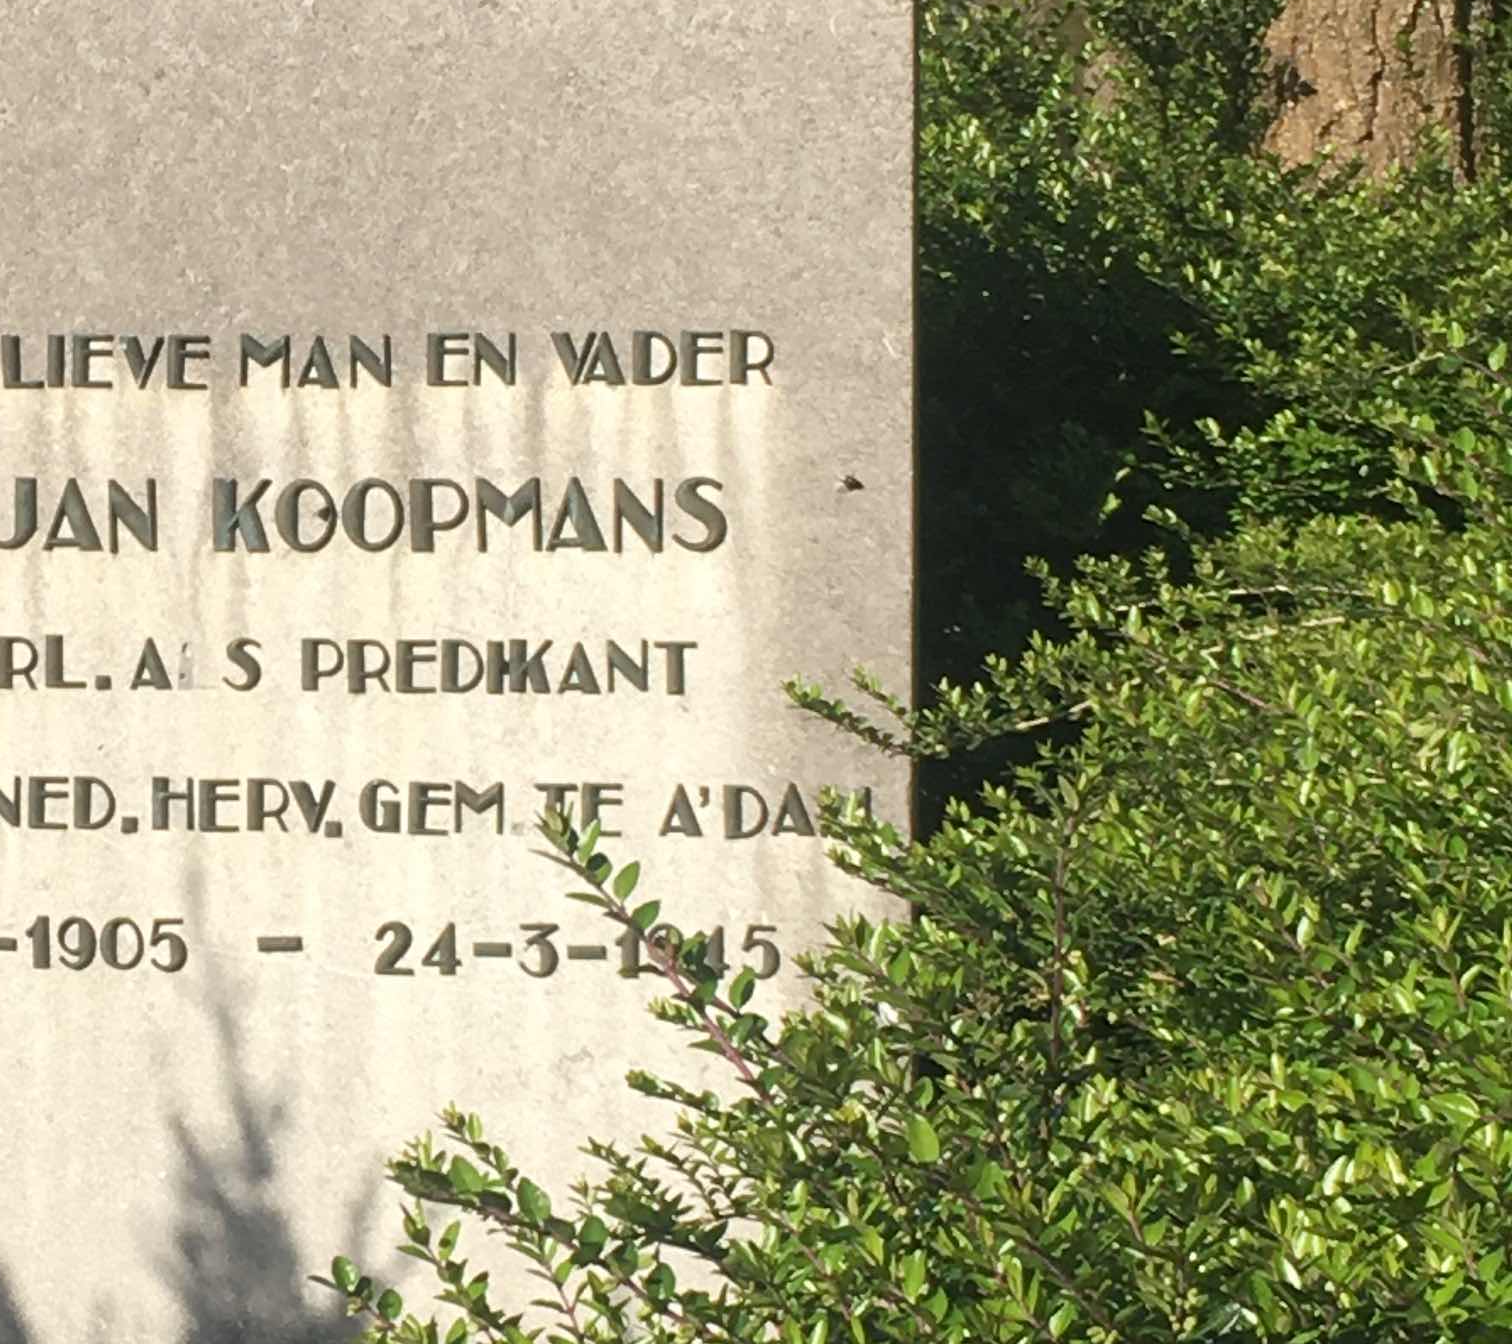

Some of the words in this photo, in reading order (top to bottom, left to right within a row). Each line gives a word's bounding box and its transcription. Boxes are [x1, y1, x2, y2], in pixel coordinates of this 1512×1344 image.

[1, 334, 211, 389] LIEVE
[239, 333, 392, 389] MAN
[426, 331, 518, 387] EN
[550, 330, 776, 387] VADER
[211, 476, 729, 554] KOOPMANS
[300, 638, 699, 695] PREDIKANT
[534, 782, 624, 837] TE
[658, 781, 873, 840] A'DA
